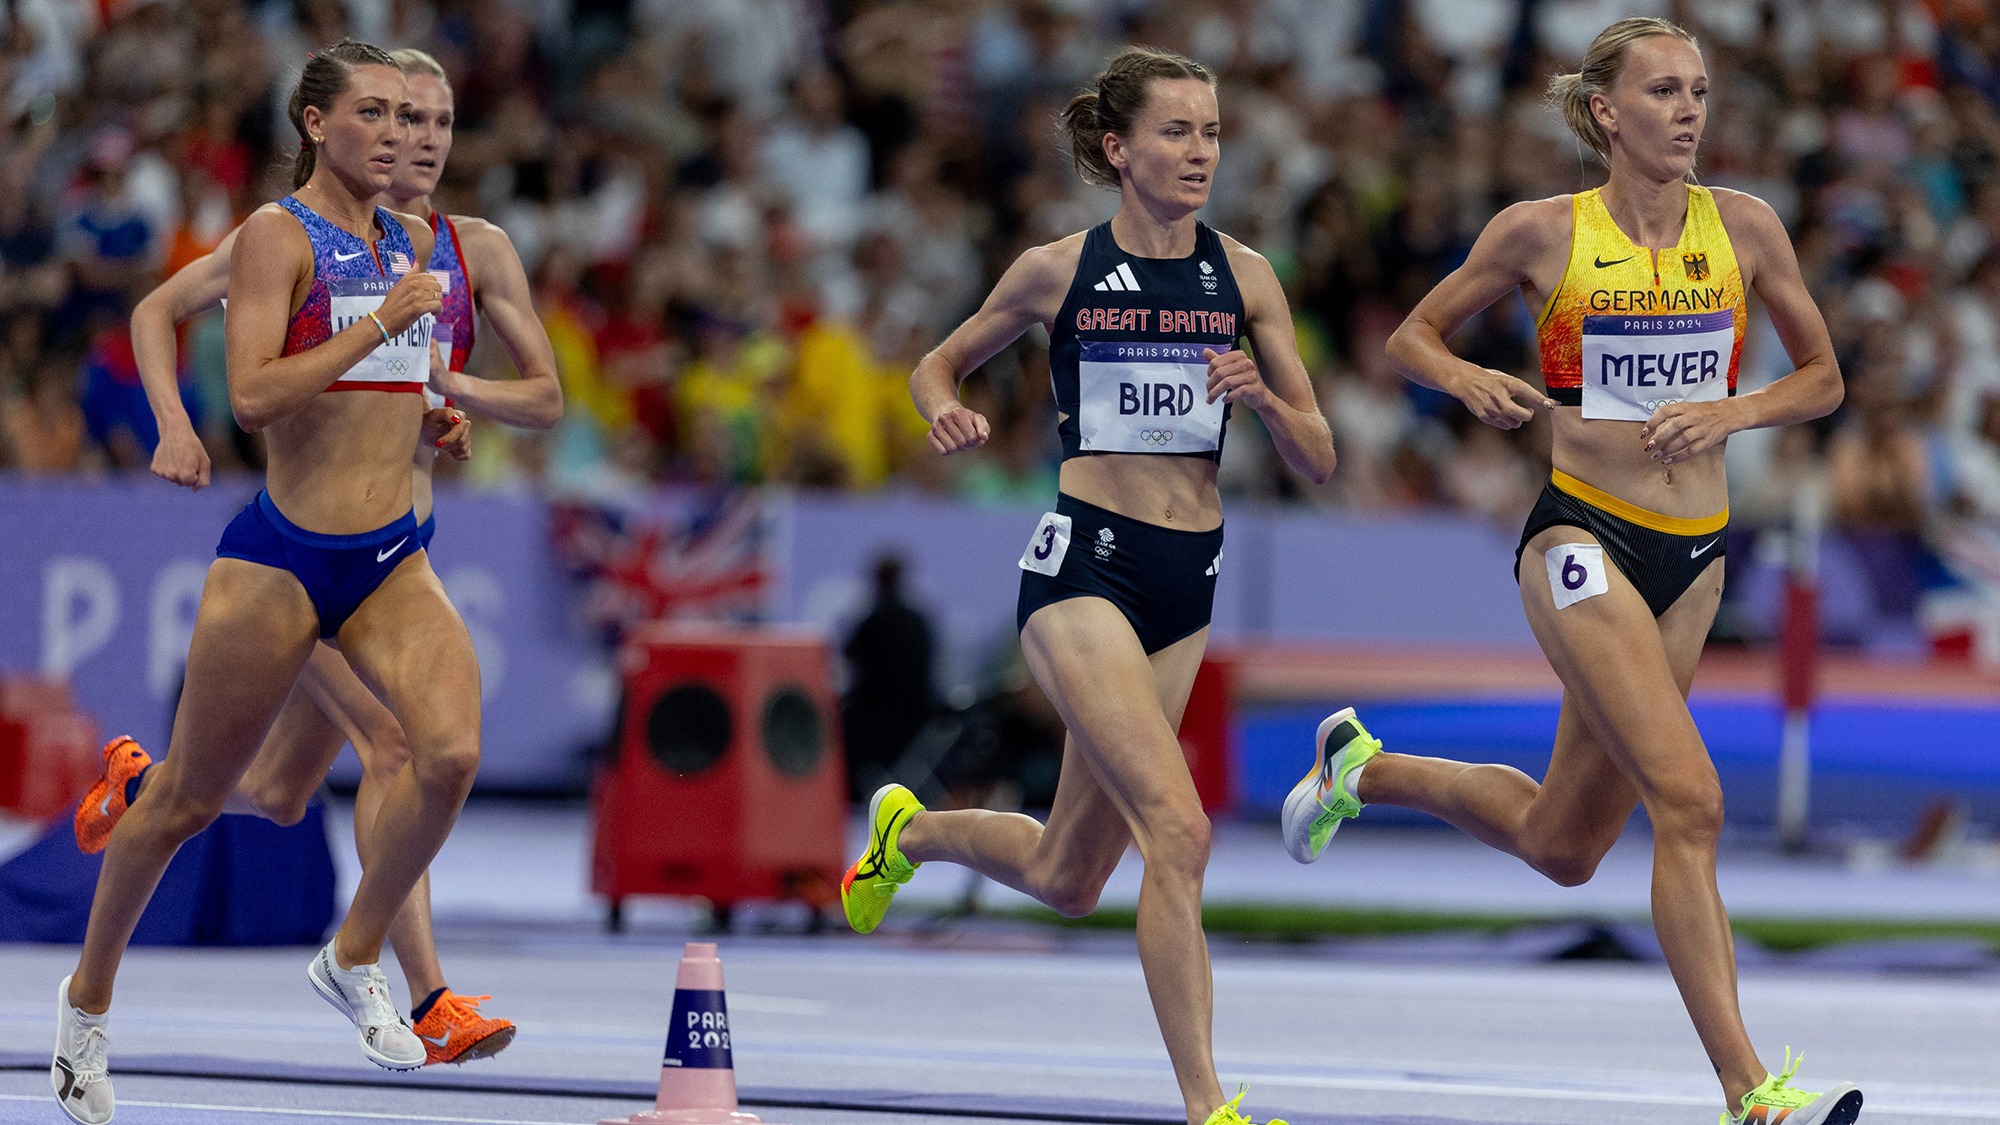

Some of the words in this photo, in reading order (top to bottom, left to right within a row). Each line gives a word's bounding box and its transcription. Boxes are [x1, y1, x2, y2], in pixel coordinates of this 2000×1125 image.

[363, 281, 394, 291] PARIS
[1590, 287, 1724, 311] GERMANY
[1076, 308, 1151, 331] GREAT
[1159, 310, 1236, 336] BRITAIN
[1624, 320, 1663, 330] PARIS
[1668, 319, 1702, 330] 2024
[1118, 347, 1158, 357] PARIS
[1163, 348, 1197, 358] 2024
[1601, 350, 1719, 387] MEYER
[1119, 382, 1194, 416] BIRD
[1034, 524, 1057, 561] 3
[1561, 554, 1588, 591] 6
[687, 1011, 727, 1029] PAR
[688, 1030, 730, 1049] 202
